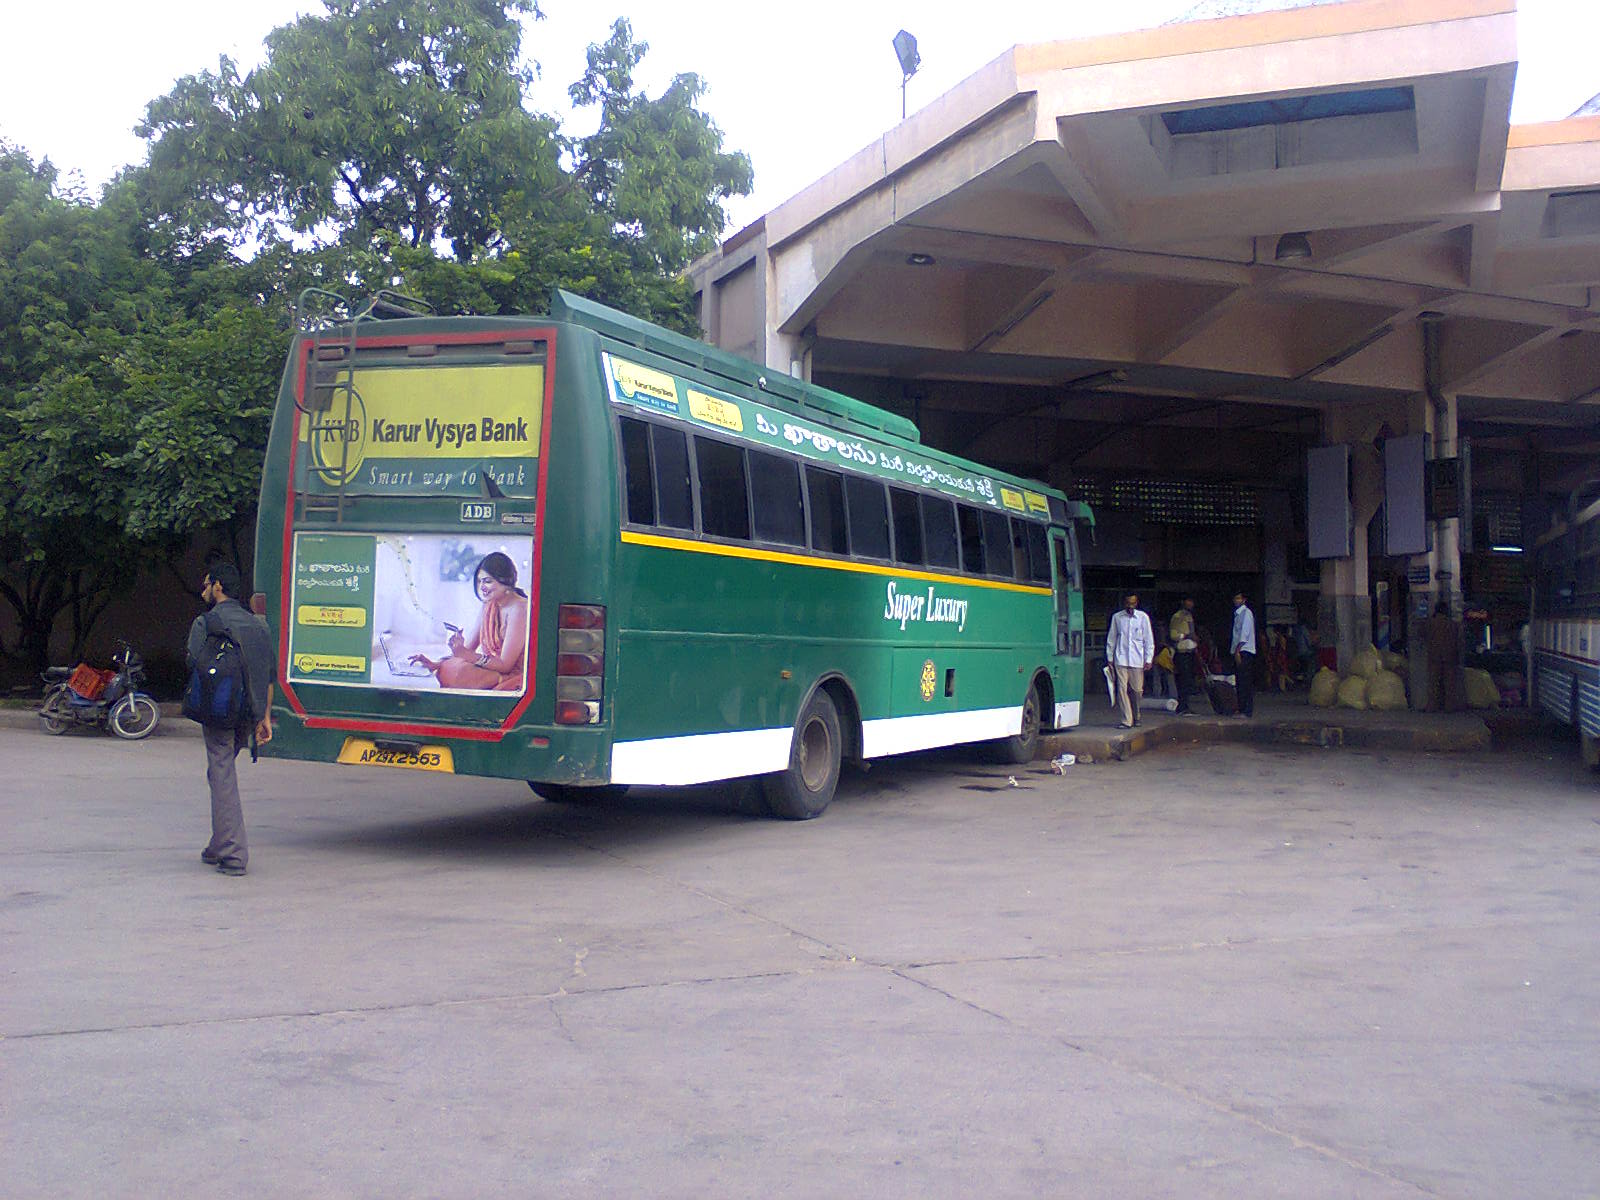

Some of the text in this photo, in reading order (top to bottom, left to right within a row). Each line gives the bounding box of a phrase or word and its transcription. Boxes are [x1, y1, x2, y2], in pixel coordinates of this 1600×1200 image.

[372, 418, 421, 443] Karur
[425, 417, 476, 449] Vysya
[481, 416, 528, 442] Bank
[368, 464, 525, 490] Smart way to bank
[463, 505, 492, 518] ADB
[884, 581, 968, 632] Super Luxury
